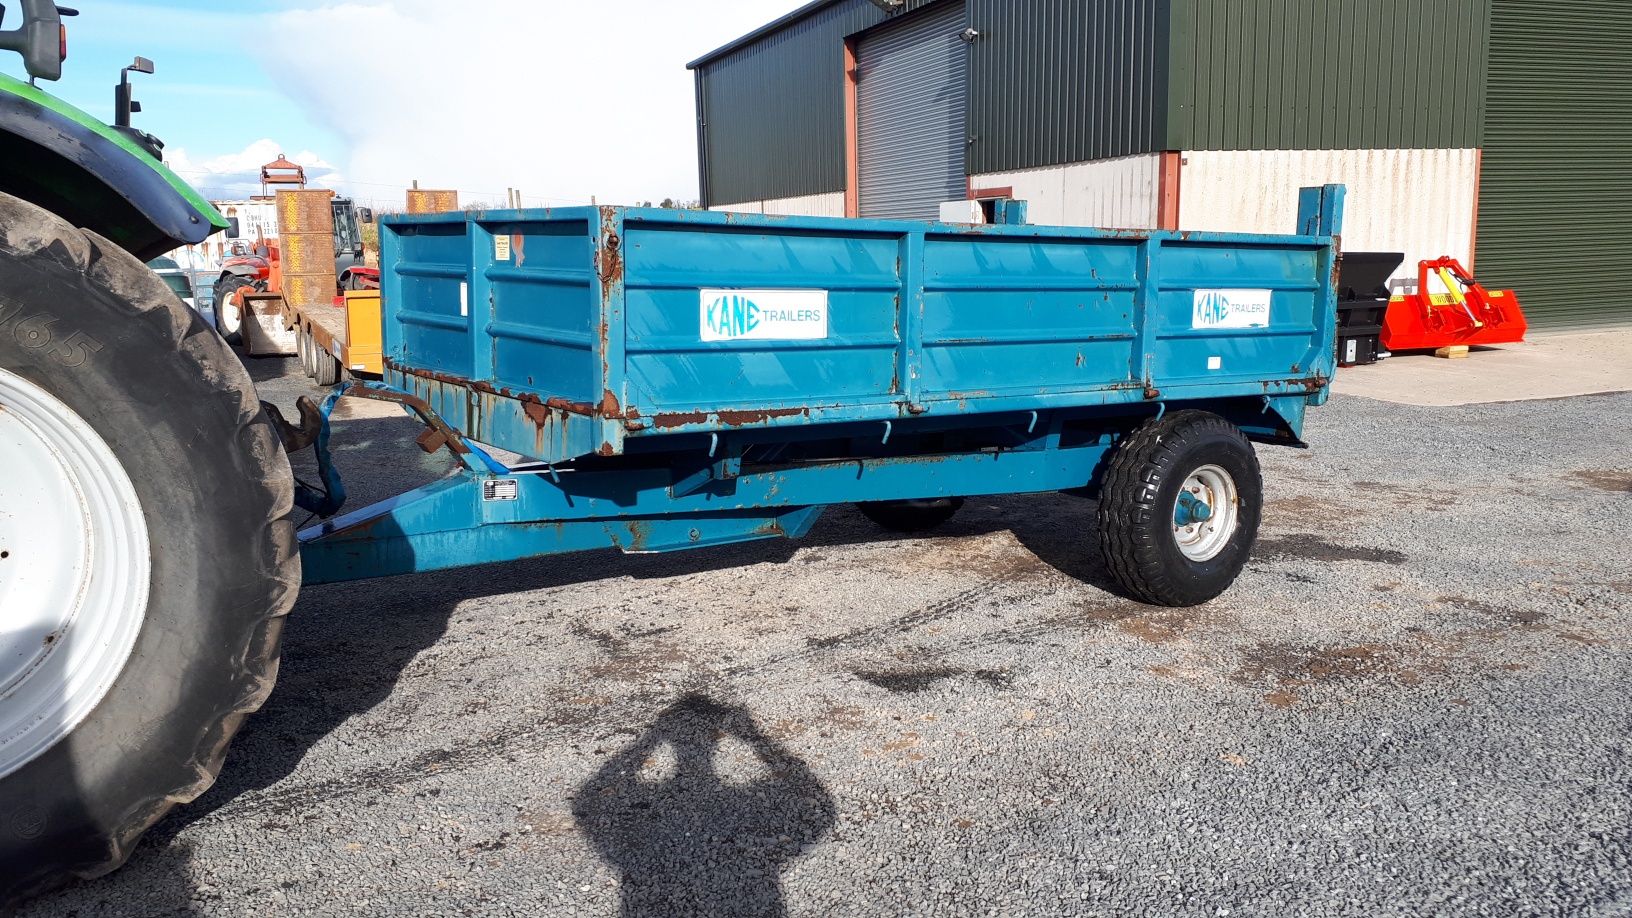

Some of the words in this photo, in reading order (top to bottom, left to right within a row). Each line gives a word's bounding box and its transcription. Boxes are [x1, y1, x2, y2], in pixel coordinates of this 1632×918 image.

[707, 295, 760, 337] KANE
[762, 310, 821, 322] TRAILERS
[1197, 292, 1229, 324] KANE
[1231, 303, 1266, 313] TRAILERS
